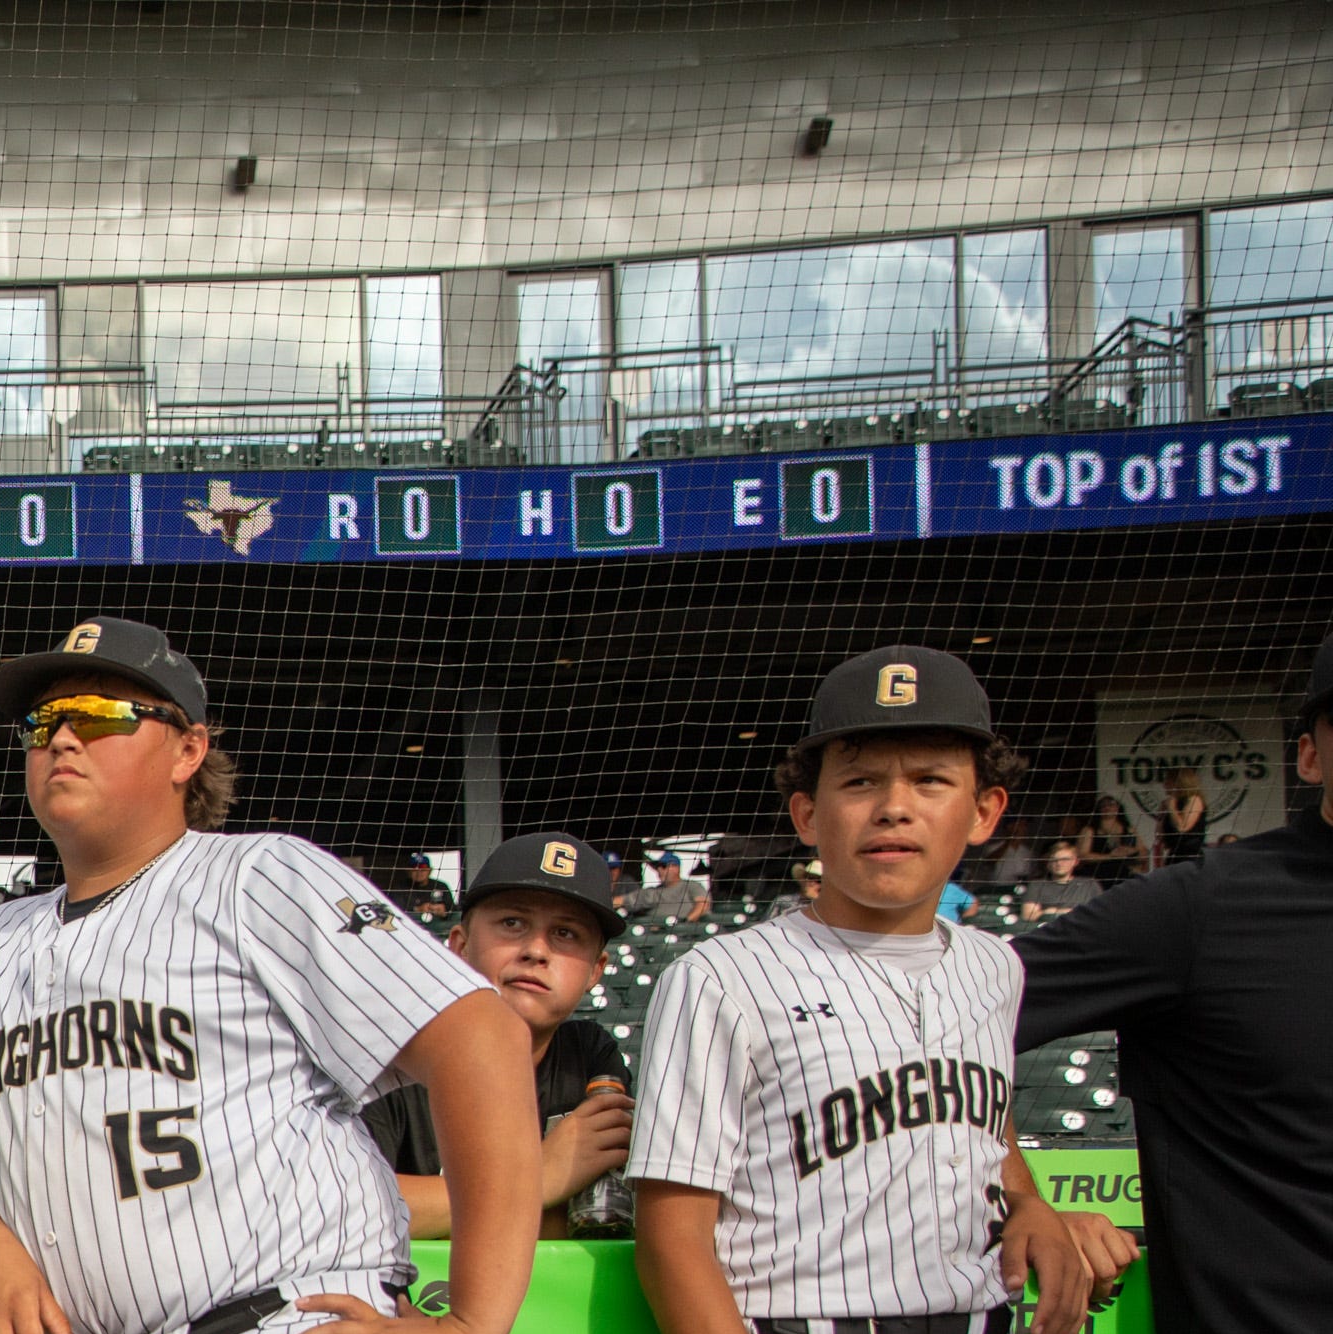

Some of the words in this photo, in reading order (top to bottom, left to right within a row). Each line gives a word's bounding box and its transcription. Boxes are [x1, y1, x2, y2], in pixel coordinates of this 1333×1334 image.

[989, 450, 1106, 511] TOP
[1119, 441, 1184, 503] of
[328, 493, 361, 540] R
[520, 490, 554, 537] H
[733, 478, 764, 526] E
[63, 623, 103, 655] G
[876, 663, 918, 707] G
[540, 840, 578, 877] G
[355, 905, 377, 922] G
[105, 1105, 204, 1202] 15
